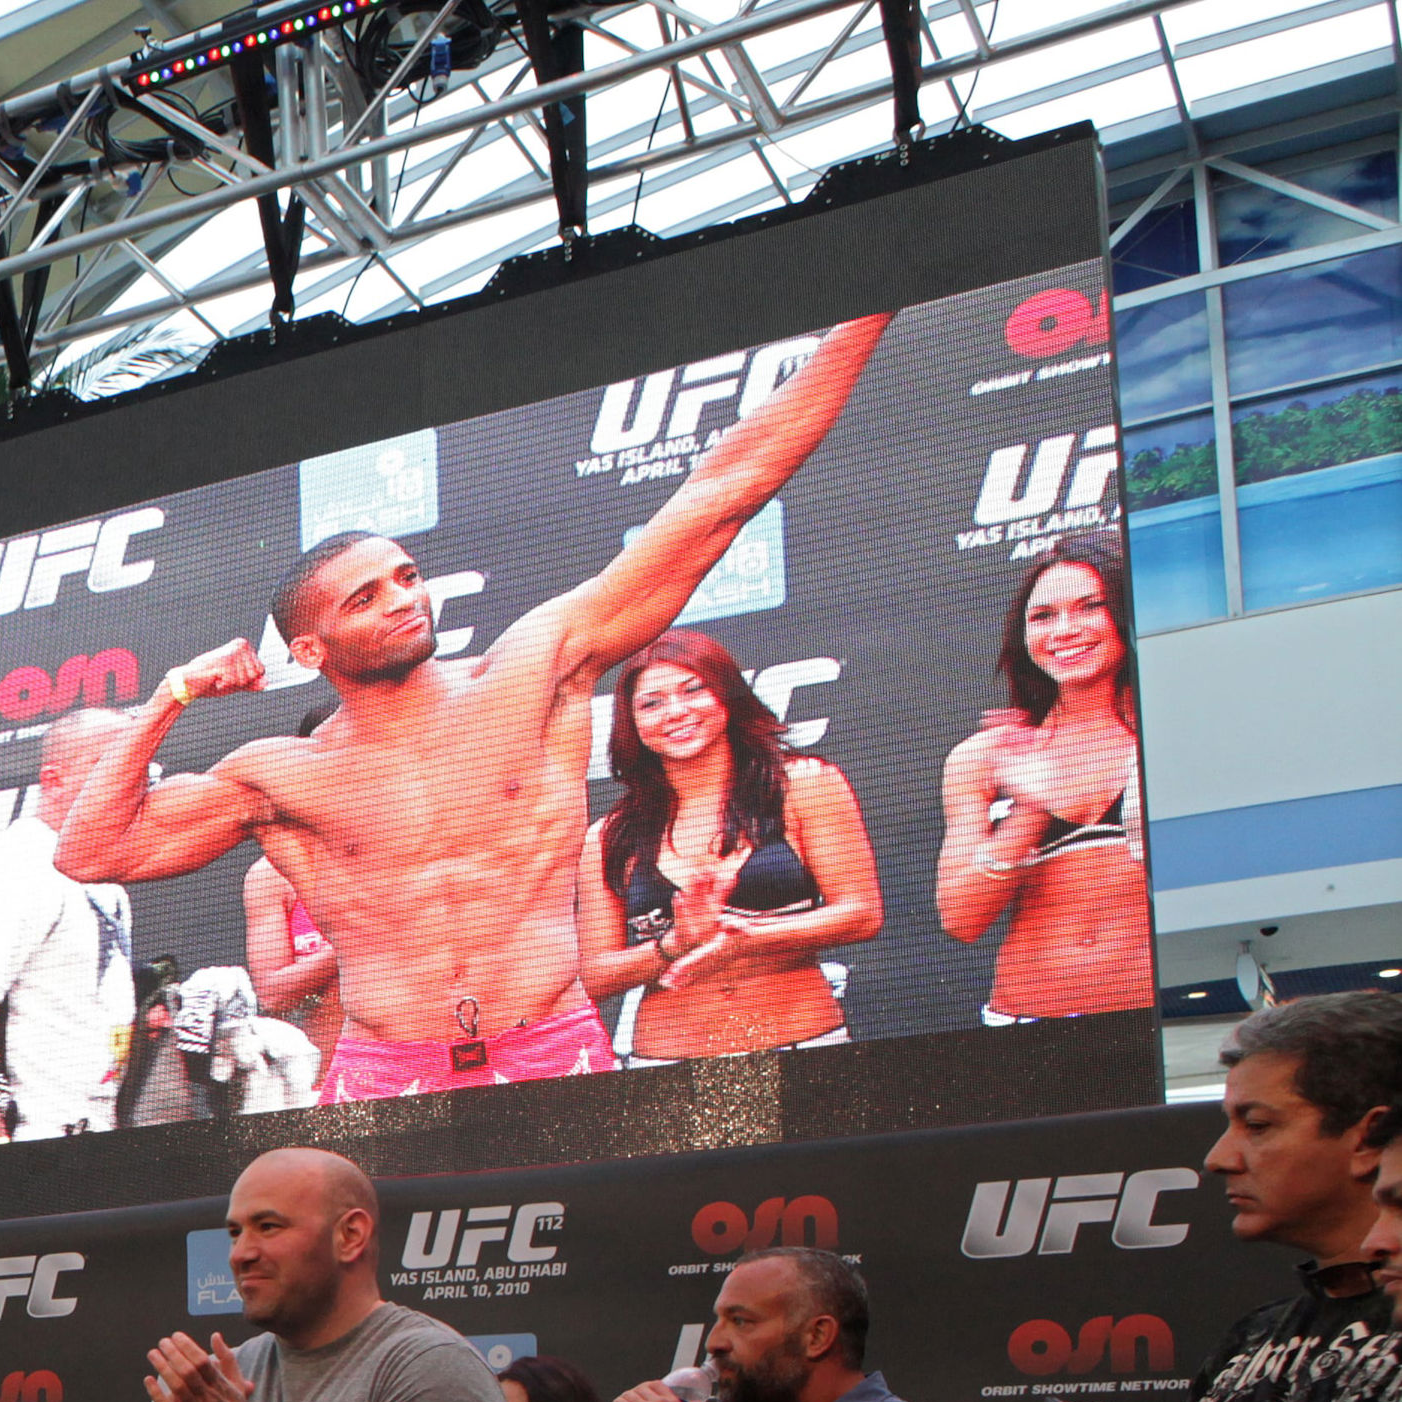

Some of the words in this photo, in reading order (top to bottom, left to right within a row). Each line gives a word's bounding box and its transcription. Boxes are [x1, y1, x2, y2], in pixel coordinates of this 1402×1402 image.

[575, 453, 616, 478] YAS
[619, 458, 685, 486] APRIL
[973, 425, 1119, 525] UF
[960, 1167, 1200, 1259] UFC
[401, 1202, 565, 1269] UFC
[537, 1216, 565, 1231] 112
[390, 1272, 417, 1286] YAS
[421, 1268, 480, 1285] ISLAND,
[483, 1266, 515, 1280] ABU
[519, 1262, 567, 1278] DHABI
[668, 1262, 710, 1276] ORBIT
[197, 1288, 243, 1305] FLA
[423, 1285, 468, 1300] APRIL
[472, 1284, 491, 1298] 10,
[495, 1282, 530, 1296] 2010
[981, 1384, 1028, 1396] ORBIT
[1031, 1381, 1116, 1395] SHOWTIME
[1120, 1378, 1191, 1391] NETWOR
